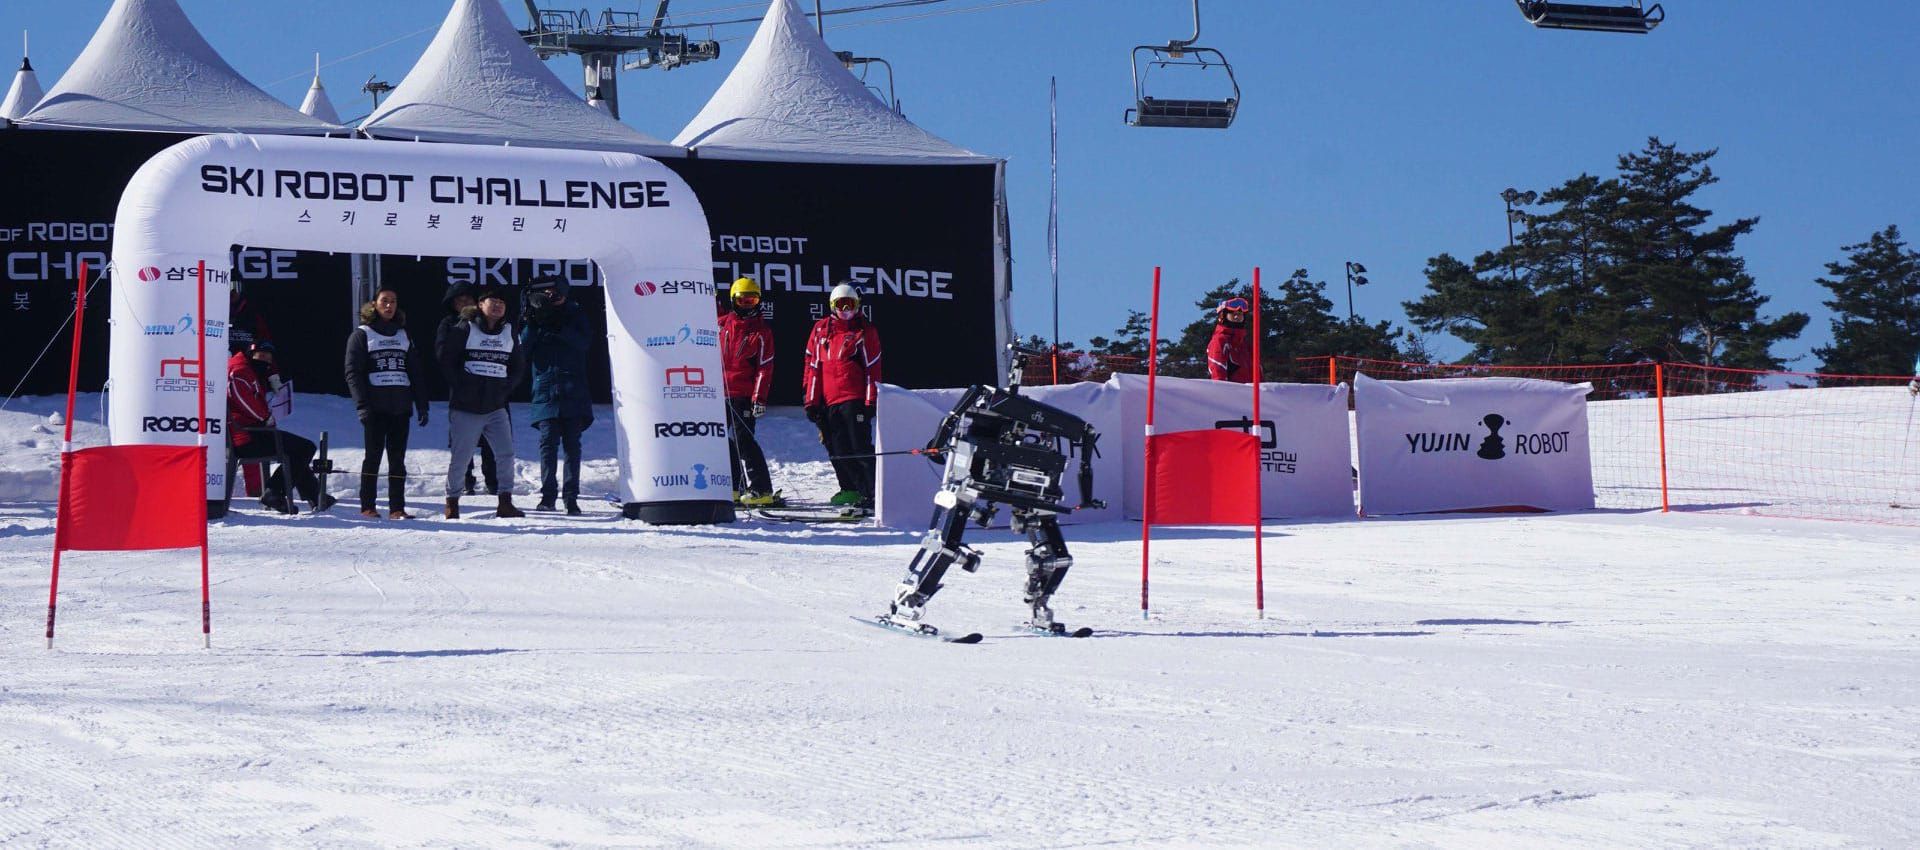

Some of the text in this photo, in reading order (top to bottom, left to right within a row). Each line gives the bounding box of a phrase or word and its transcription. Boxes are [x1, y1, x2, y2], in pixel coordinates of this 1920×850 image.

[201, 164, 670, 210] SKI ROBOT CHALLENGE
[28, 222, 115, 241] ROBO
[719, 234, 809, 255] ROBOT
[712, 261, 953, 300] CHALLENGE
[1405, 431, 1570, 455] YUJIN ROBOT
[652, 473, 689, 487] YUJIN
